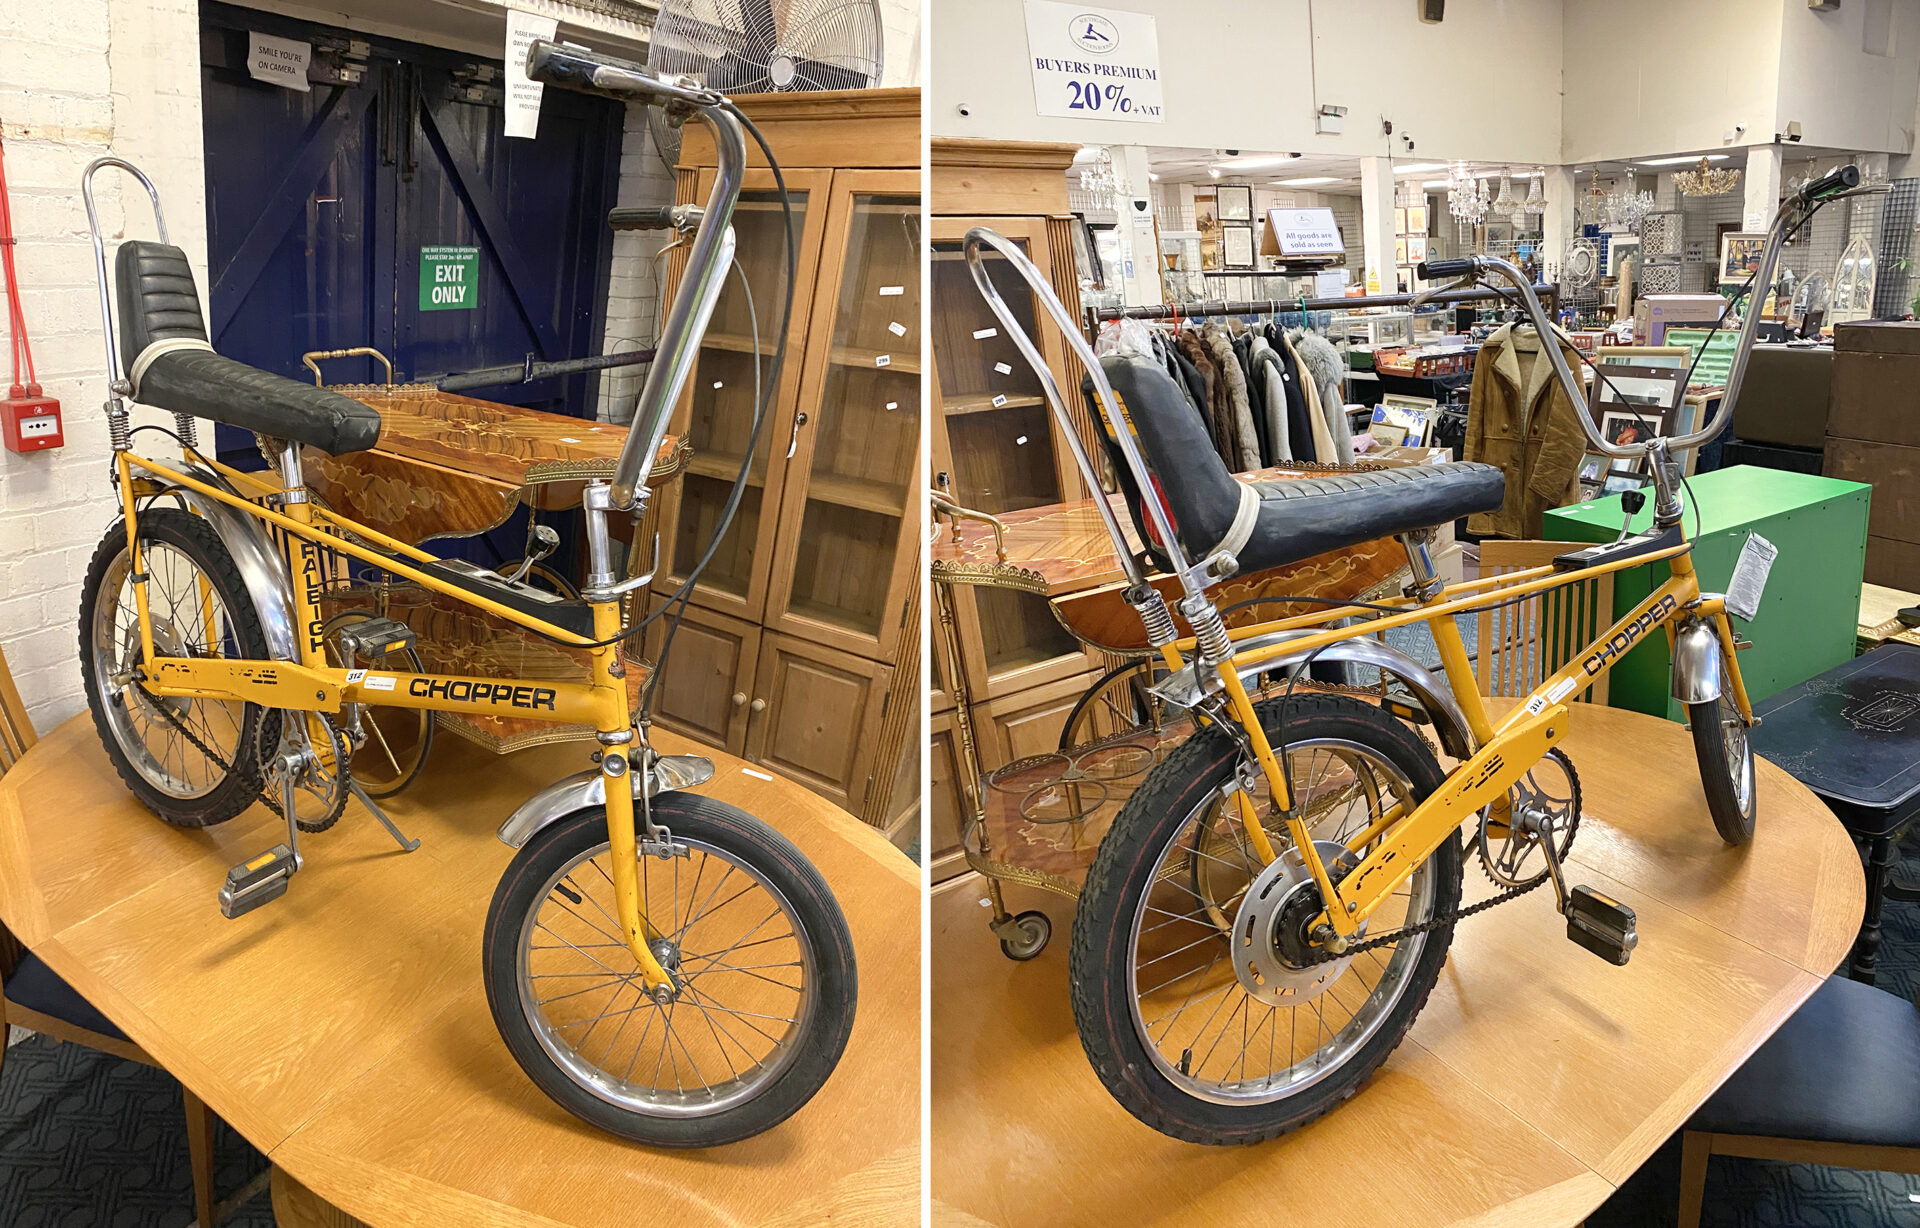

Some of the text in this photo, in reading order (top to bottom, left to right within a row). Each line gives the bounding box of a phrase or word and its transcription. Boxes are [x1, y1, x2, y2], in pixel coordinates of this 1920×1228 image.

[258, 46, 303, 63] SMILE YOU'RE
[258, 61, 296, 75] ON CAMERA
[1036, 57, 1157, 81] BUYERS PREMIUM
[1066, 80, 1132, 113] 20%
[1141, 105, 1161, 116] VAT
[1297, 232, 1320, 241] goods
[436, 265, 465, 282] EXIT
[432, 286, 466, 304] ONLY
[301, 543, 324, 654] RALEIGH
[1582, 593, 1677, 677] CHOPPER
[348, 671, 363, 681] 312
[409, 677, 557, 711] CHOPPER
[1529, 698, 1543, 713] 312
